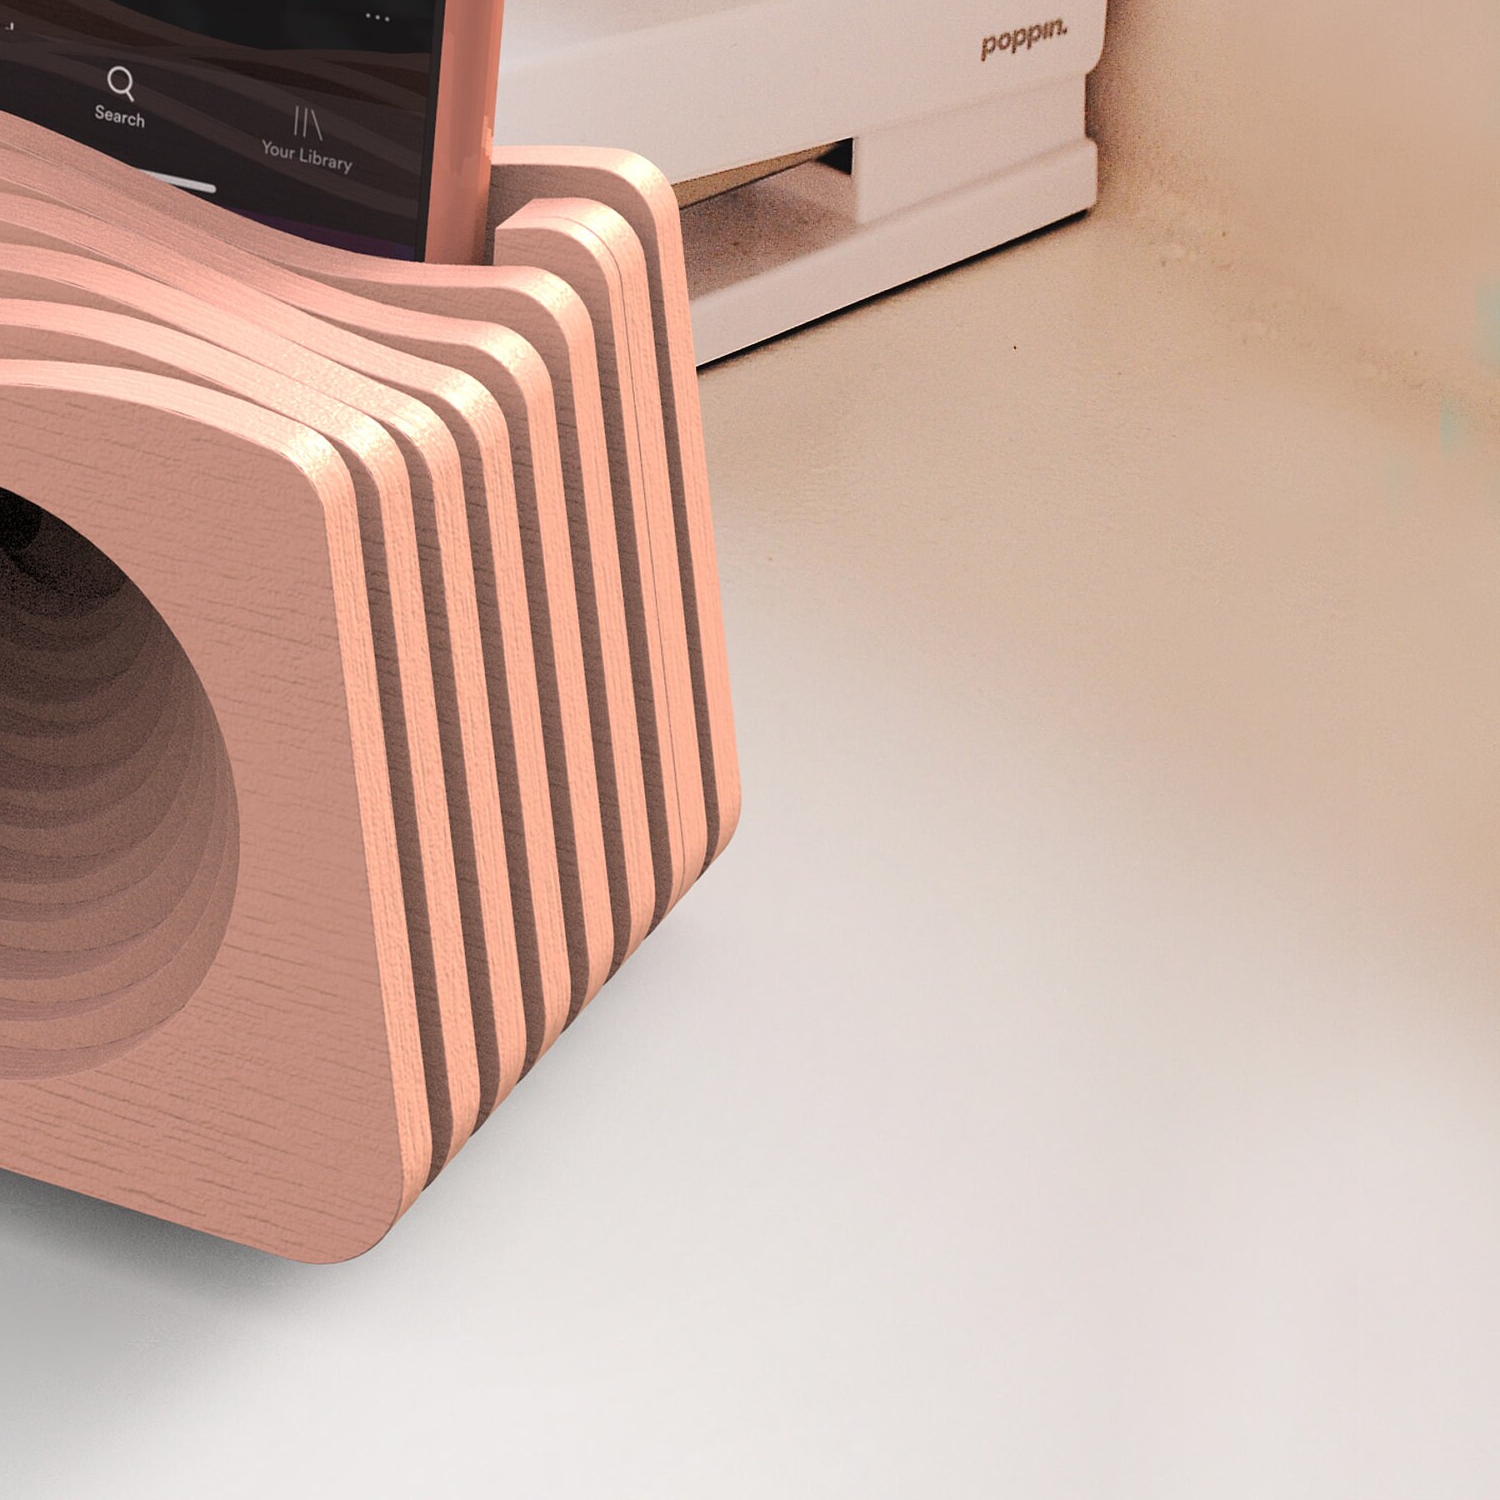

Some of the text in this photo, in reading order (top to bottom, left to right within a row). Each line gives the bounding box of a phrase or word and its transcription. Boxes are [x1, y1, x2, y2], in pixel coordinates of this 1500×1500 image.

[980, 18, 1068, 62] poppin.
[94, 104, 145, 128] Search
[262, 139, 353, 175] Your Library
